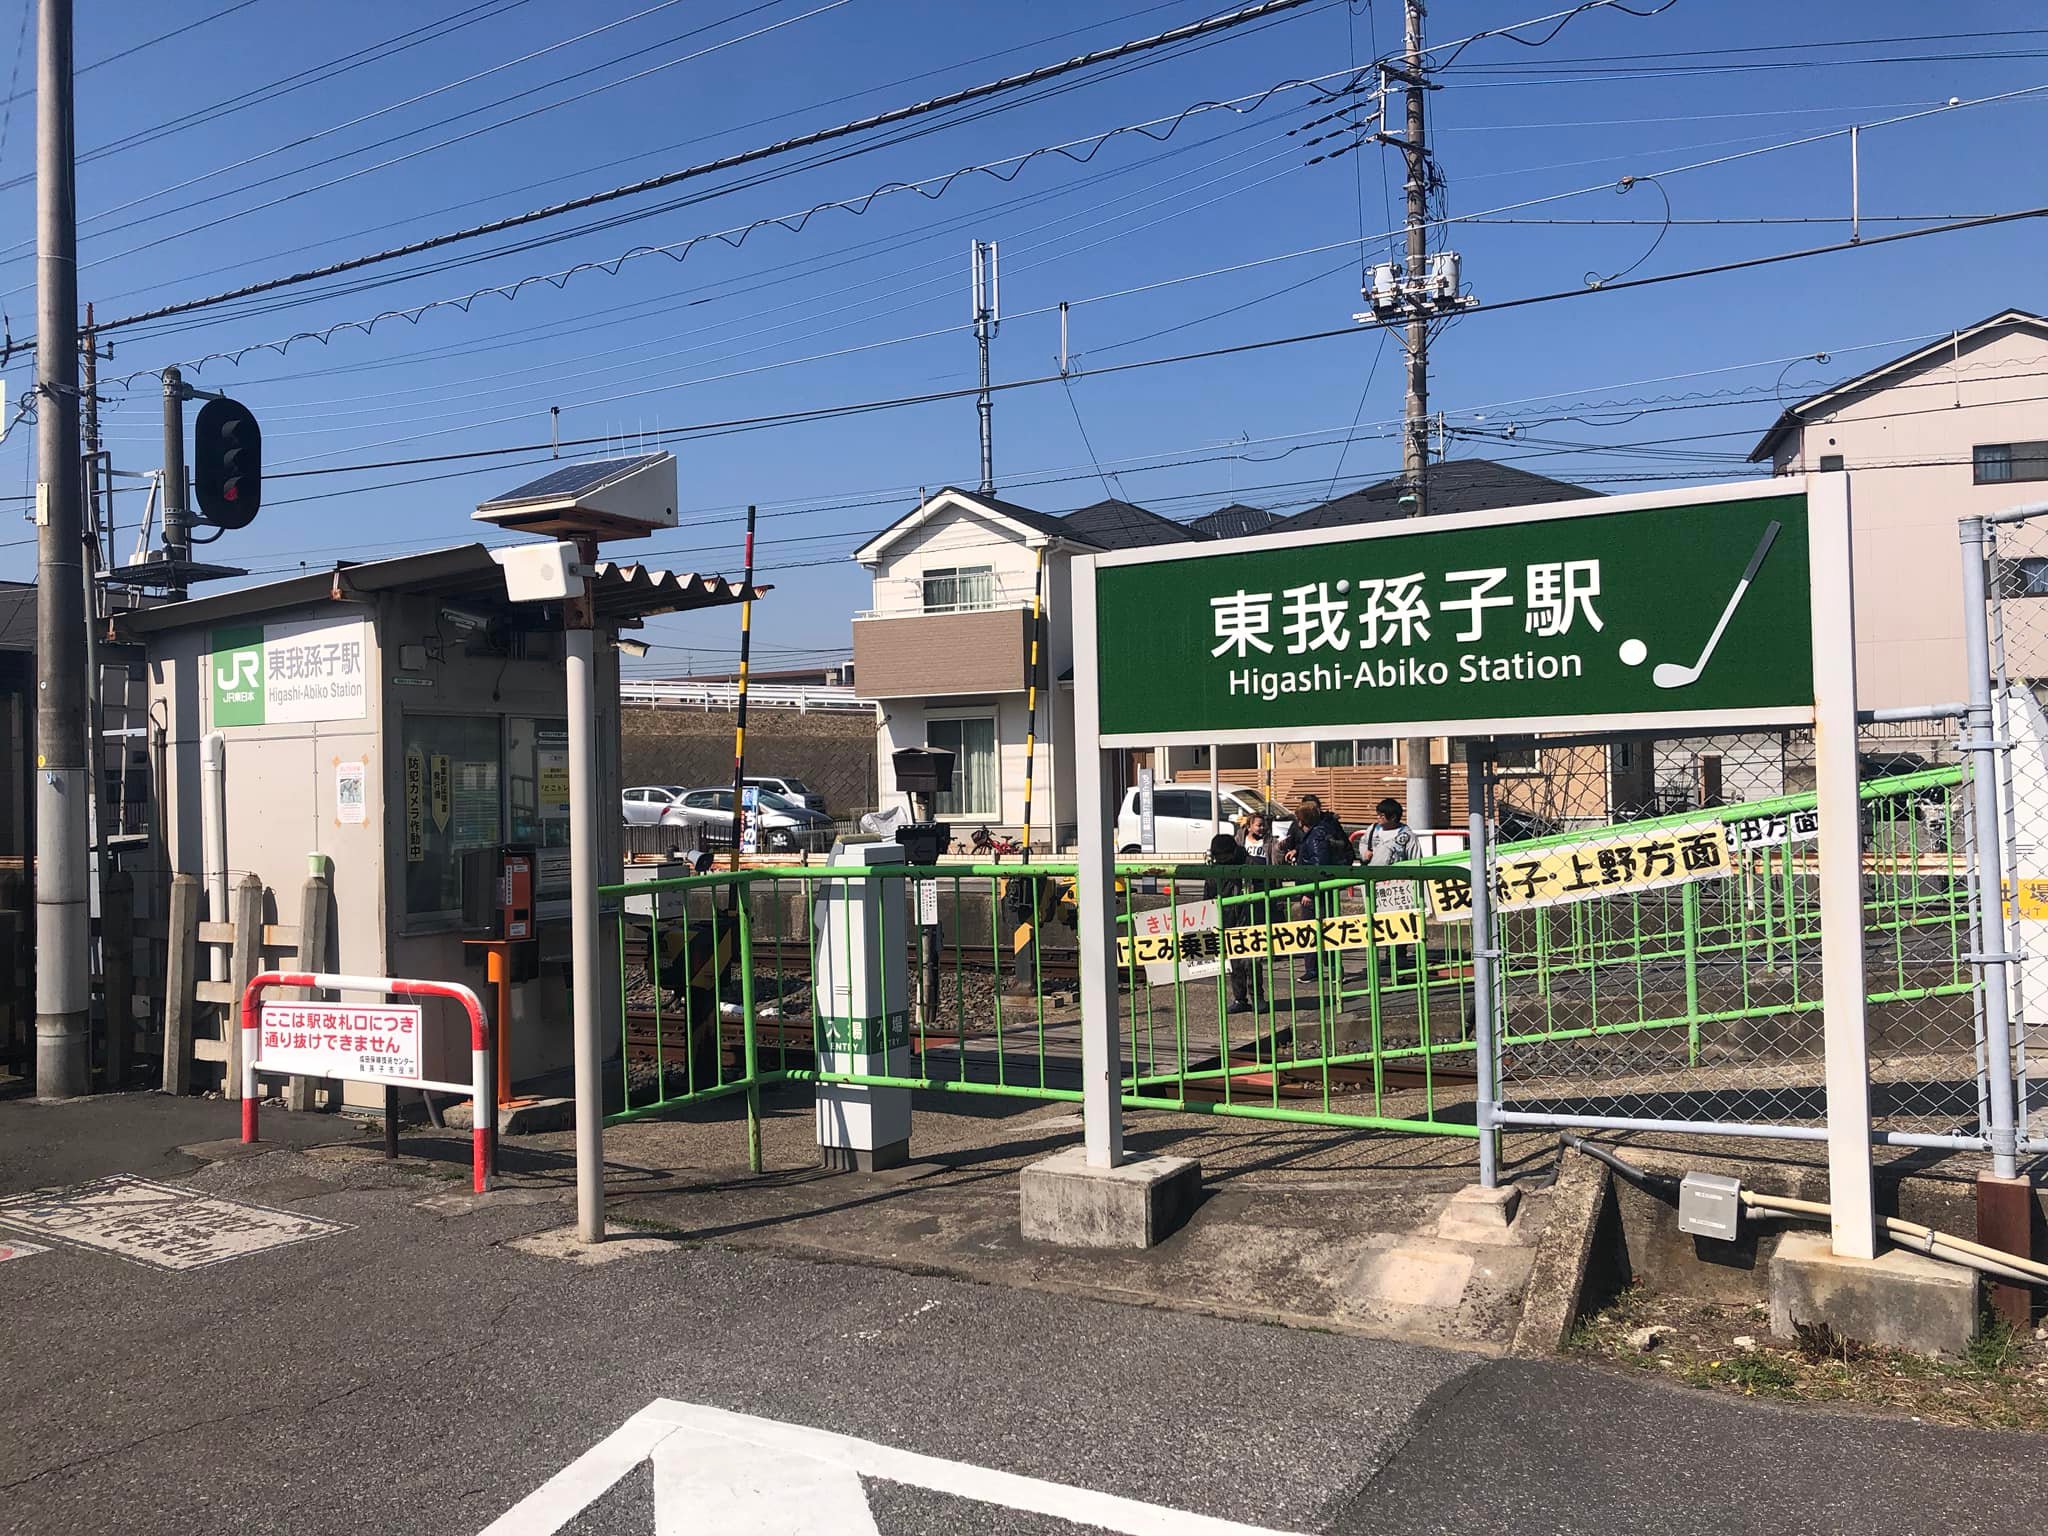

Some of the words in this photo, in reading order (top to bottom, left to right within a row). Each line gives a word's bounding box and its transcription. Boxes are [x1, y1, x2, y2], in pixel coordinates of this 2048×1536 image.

[1209, 558, 1604, 658] 東我孫子駅
[217, 651, 260, 691] JR
[268, 641, 361, 681] 東我孫子駅
[1229, 656, 1449, 701] Higashi-Abiko
[1459, 651, 1583, 683] Station
[222, 691, 255, 703] JR東日本
[269, 684, 329, 706] Higashi-Abiko
[331, 681, 362, 698] Station
[408, 757, 421, 857] 防犯カメラ作動中
[264, 1031, 401, 1054] 通り抜けできません
[265, 1012, 414, 1033] ここは駅改札口につき
